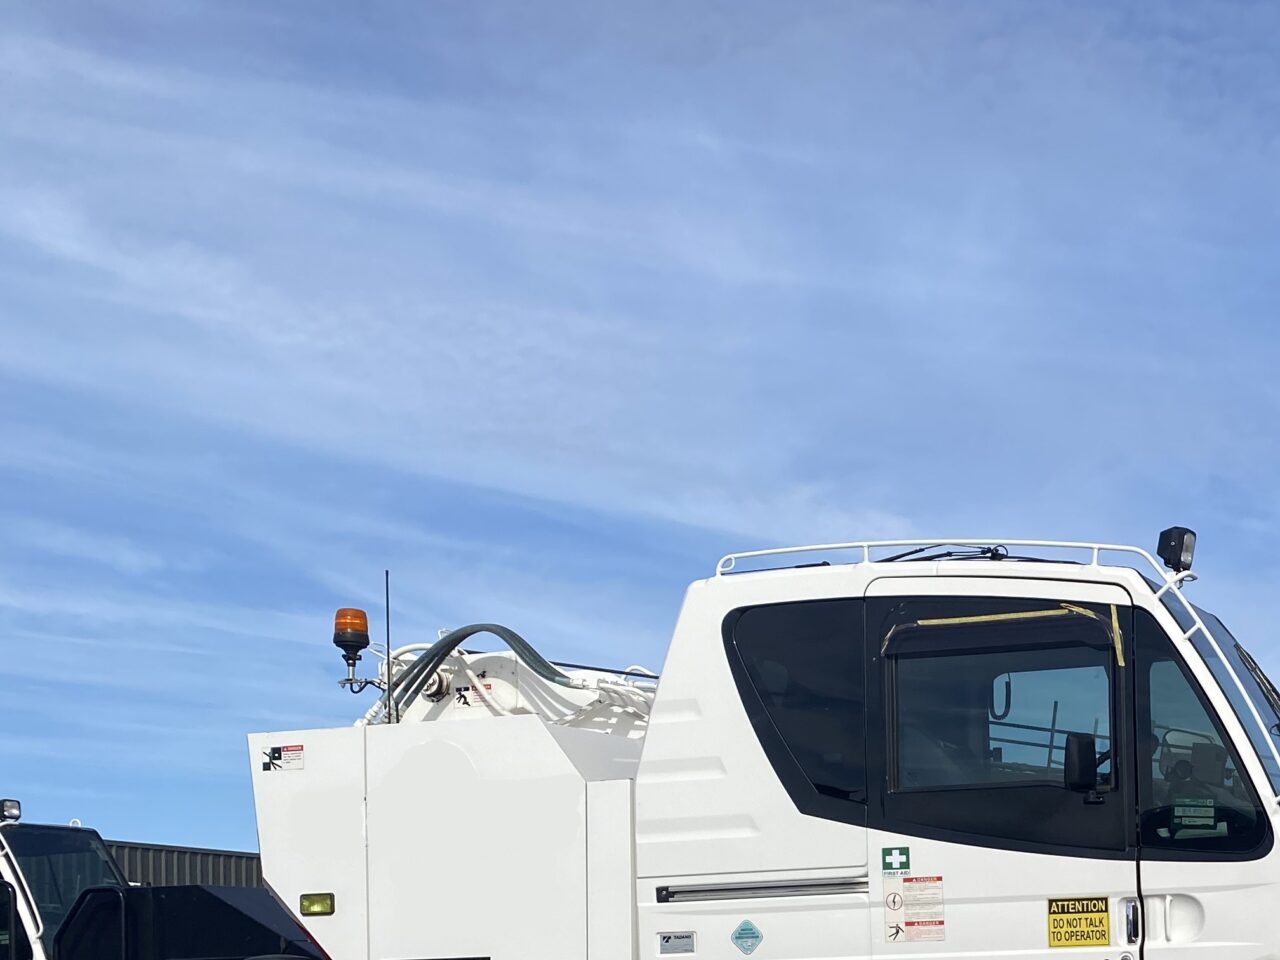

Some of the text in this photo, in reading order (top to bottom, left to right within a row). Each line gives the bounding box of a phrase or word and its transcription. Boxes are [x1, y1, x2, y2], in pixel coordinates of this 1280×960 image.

[1050, 900, 1106, 913] ATTENTION
[1053, 917, 1105, 929] DO NOT TALK
[1051, 930, 1107, 942] TO OPERATOR
